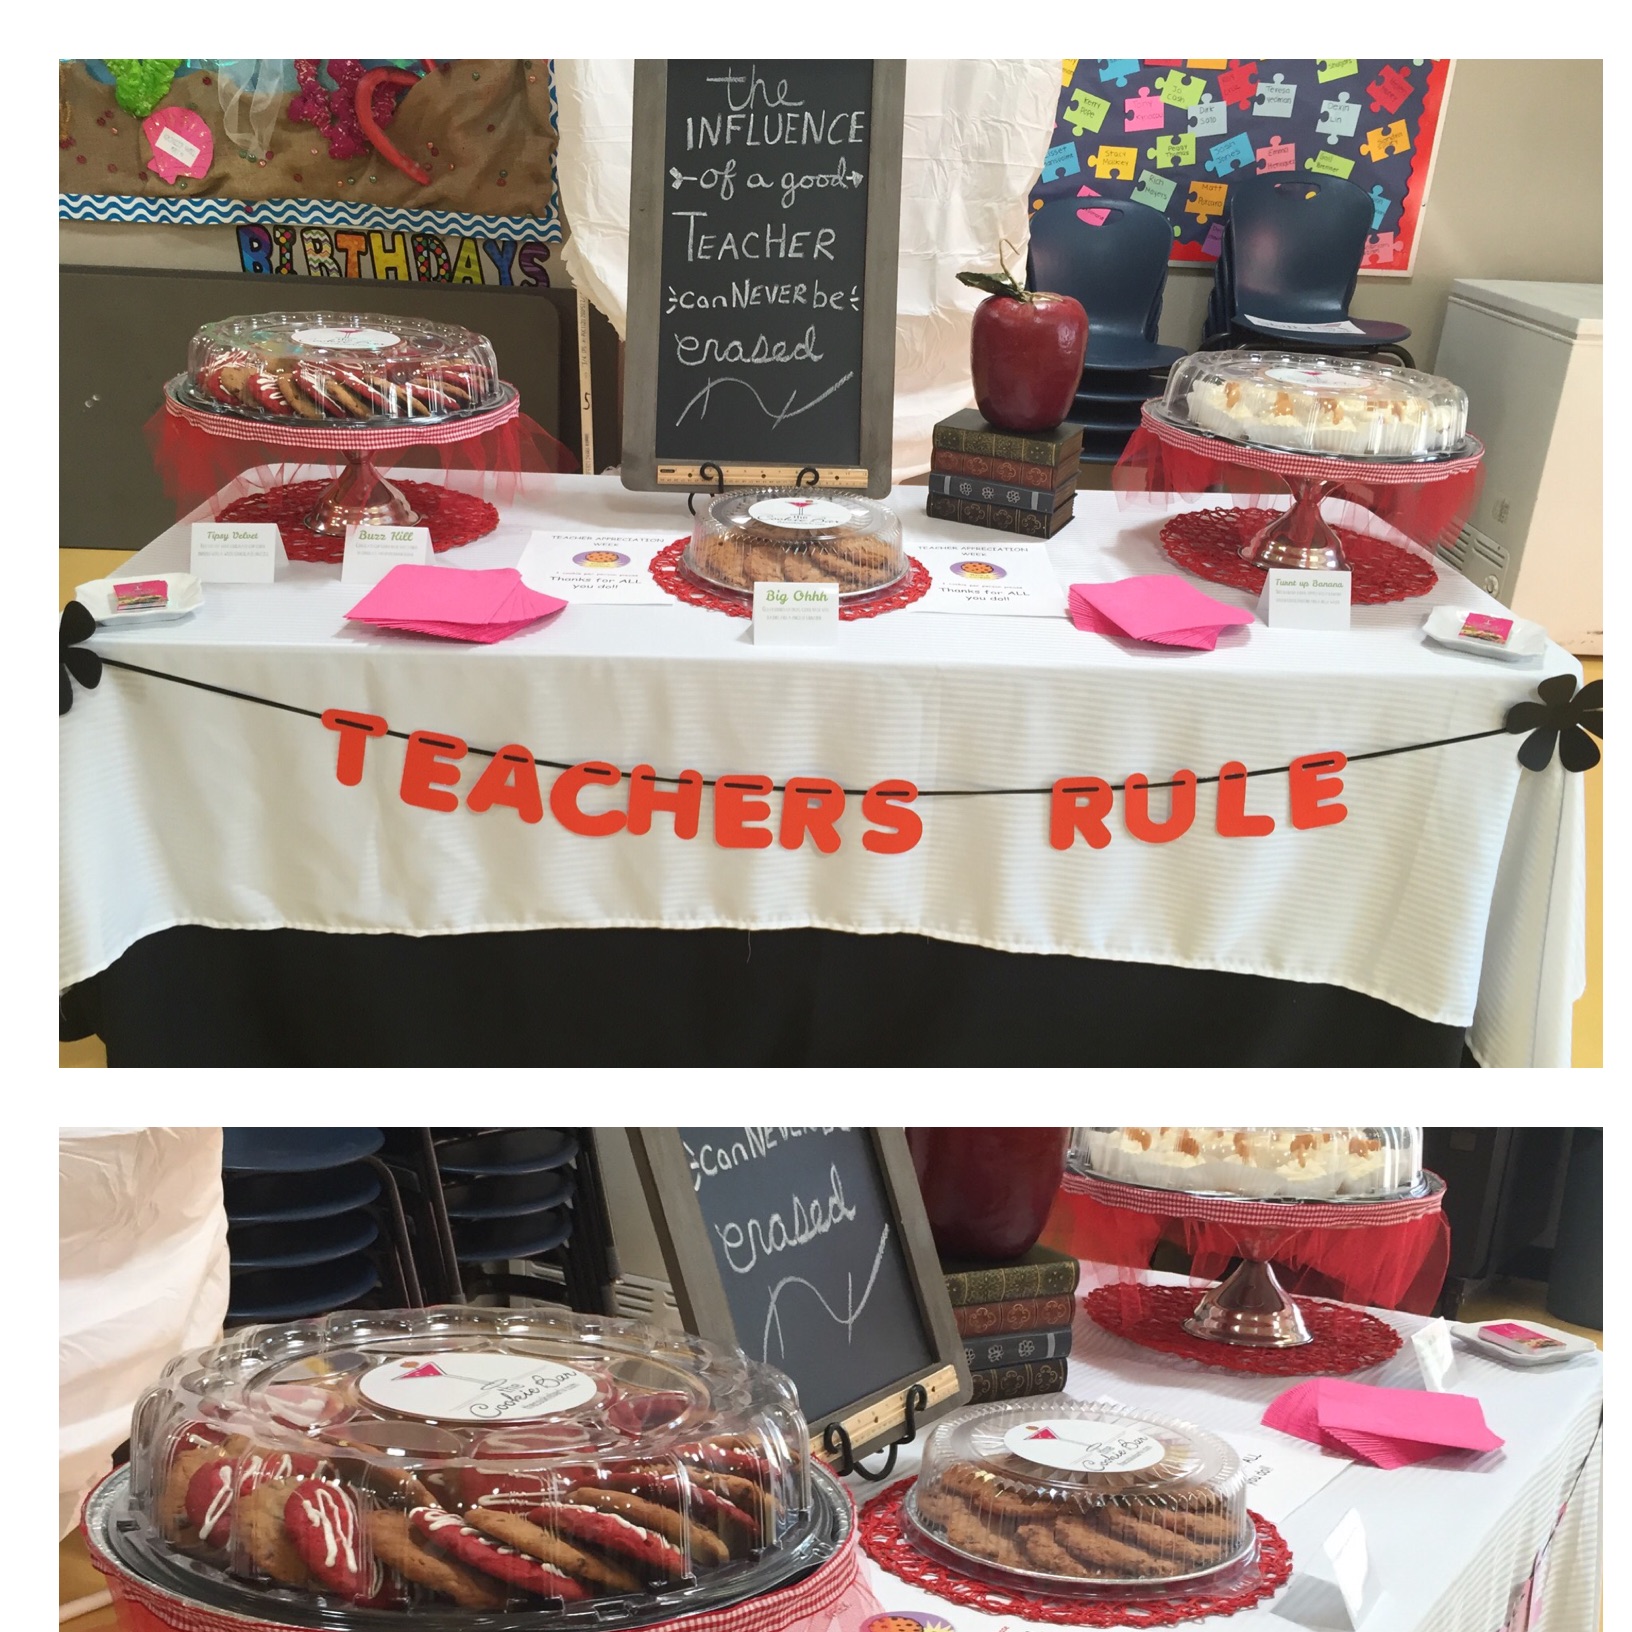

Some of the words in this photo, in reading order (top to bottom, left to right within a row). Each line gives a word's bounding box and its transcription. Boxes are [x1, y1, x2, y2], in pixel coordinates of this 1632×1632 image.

[706, 64, 804, 111] the
[687, 110, 865, 150] INFLUENCE
[700, 159, 736, 200] of
[747, 173, 774, 188] a
[781, 156, 848, 208] good
[236, 224, 550, 288] BIRTHDAYS
[672, 212, 836, 261] TEACHER
[732, 279, 807, 309] NEVER
[813, 280, 845, 309] be
[674, 325, 823, 366] erased
[359, 530, 386, 541] Buzz
[391, 531, 414, 541] Kill
[765, 589, 788, 604] Big
[796, 590, 829, 602] Ohhh
[321, 708, 923, 856] TEACHERS
[1049, 751, 1349, 853] RULE
[714, 1161, 856, 1274] erased
[470, 1386, 540, 1419] Cookie
[535, 1369, 578, 1389] Bar
[1082, 1449, 1126, 1471] Cookie
